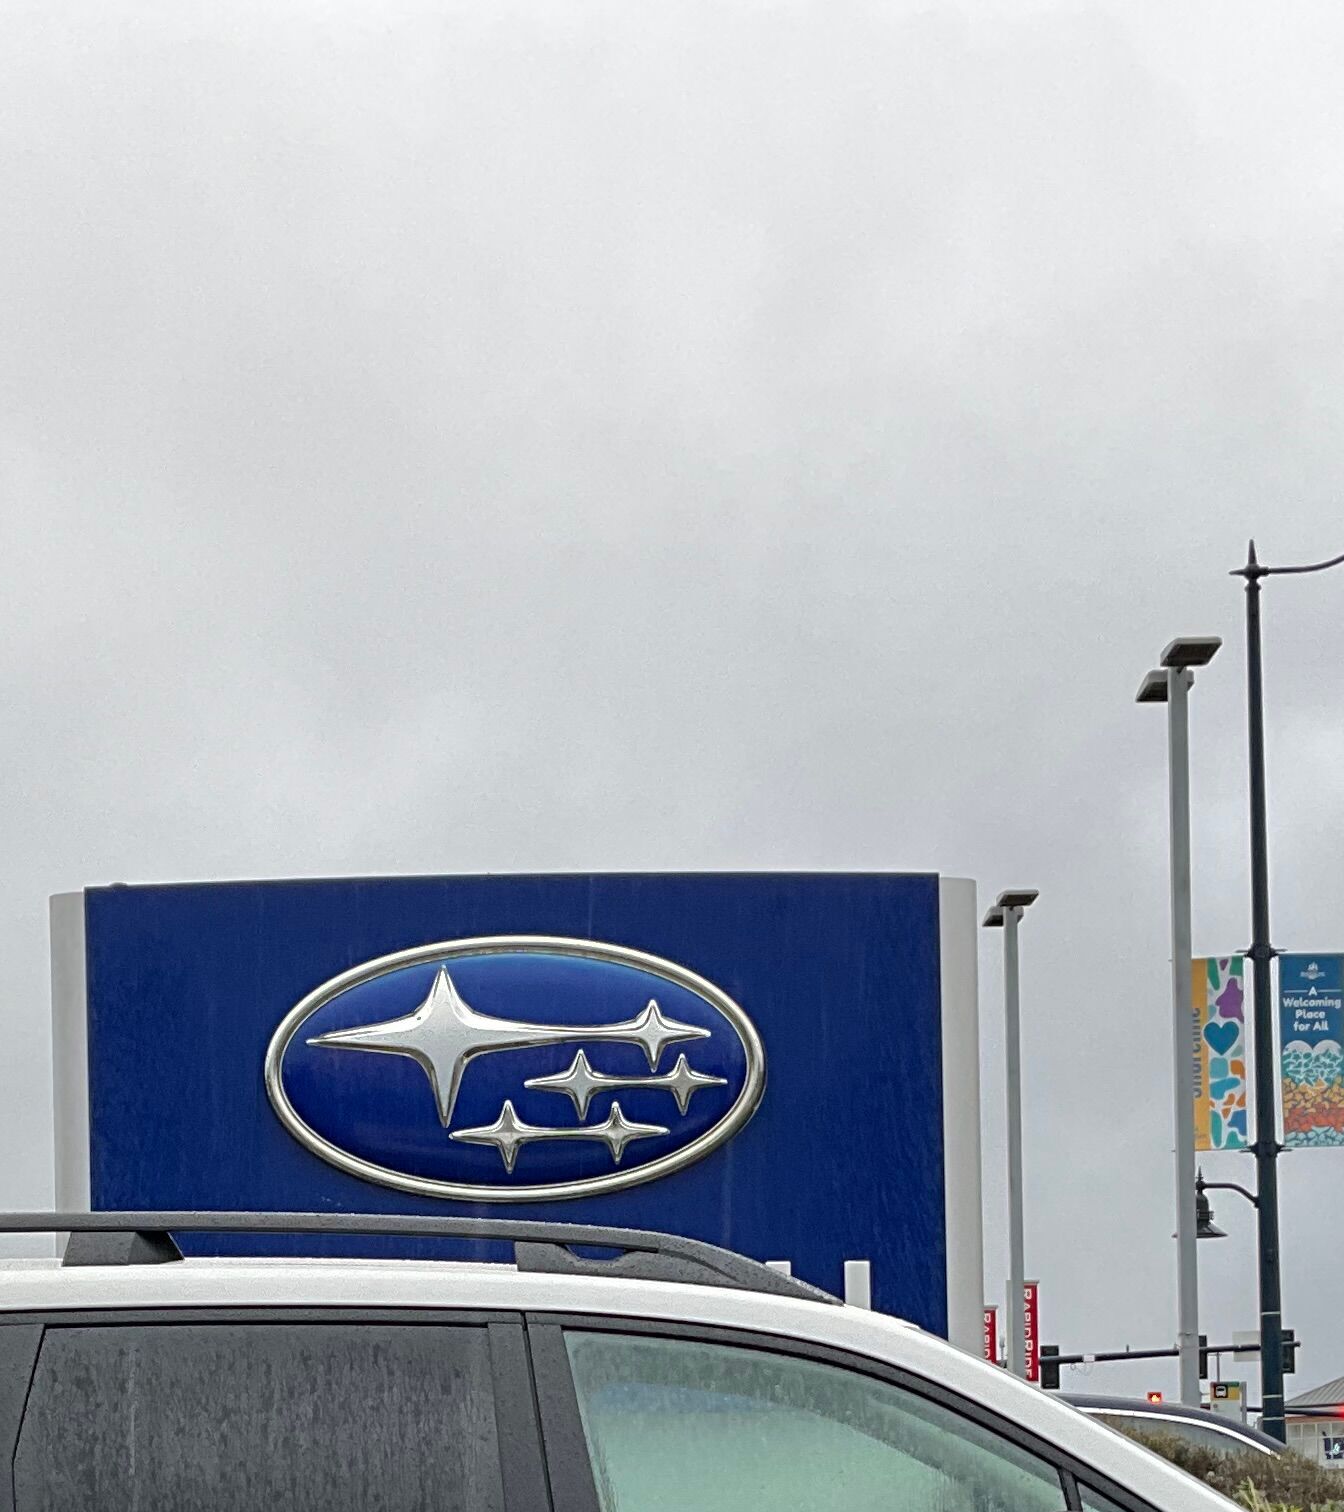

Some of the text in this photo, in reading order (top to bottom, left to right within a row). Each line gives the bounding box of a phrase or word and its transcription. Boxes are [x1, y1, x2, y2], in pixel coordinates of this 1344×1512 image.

[1308, 986, 1317, 996] A
[1283, 996, 1342, 1009] Welcoming
[1295, 1008, 1326, 1019] Place
[1293, 1020, 1329, 1032] for All
